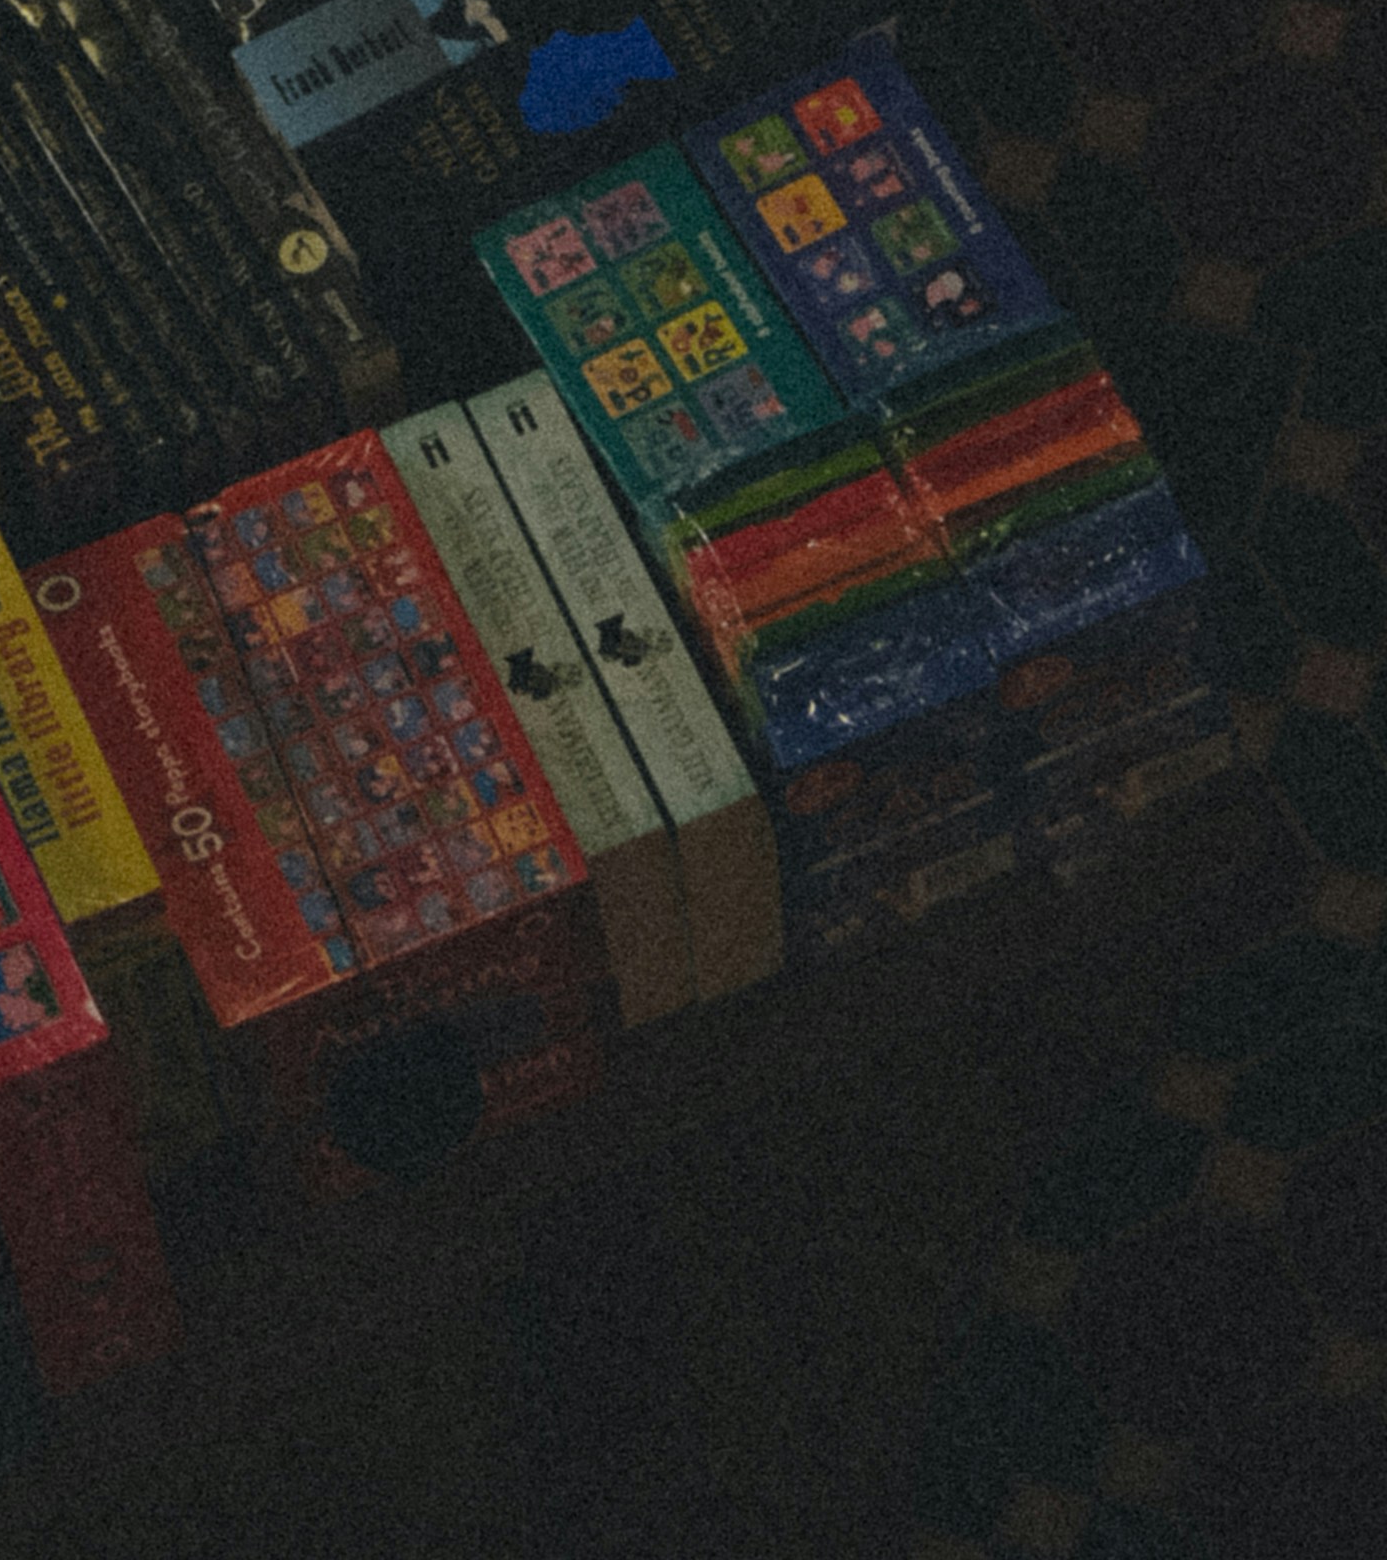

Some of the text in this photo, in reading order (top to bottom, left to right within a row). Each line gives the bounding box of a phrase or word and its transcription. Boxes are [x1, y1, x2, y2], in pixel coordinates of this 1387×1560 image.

[271, 54, 339, 108] Frank
[11, 404, 76, 466] The
[35, 737, 102, 831] little
[92, 620, 265, 964] Contains 50 Peppa storybooks
